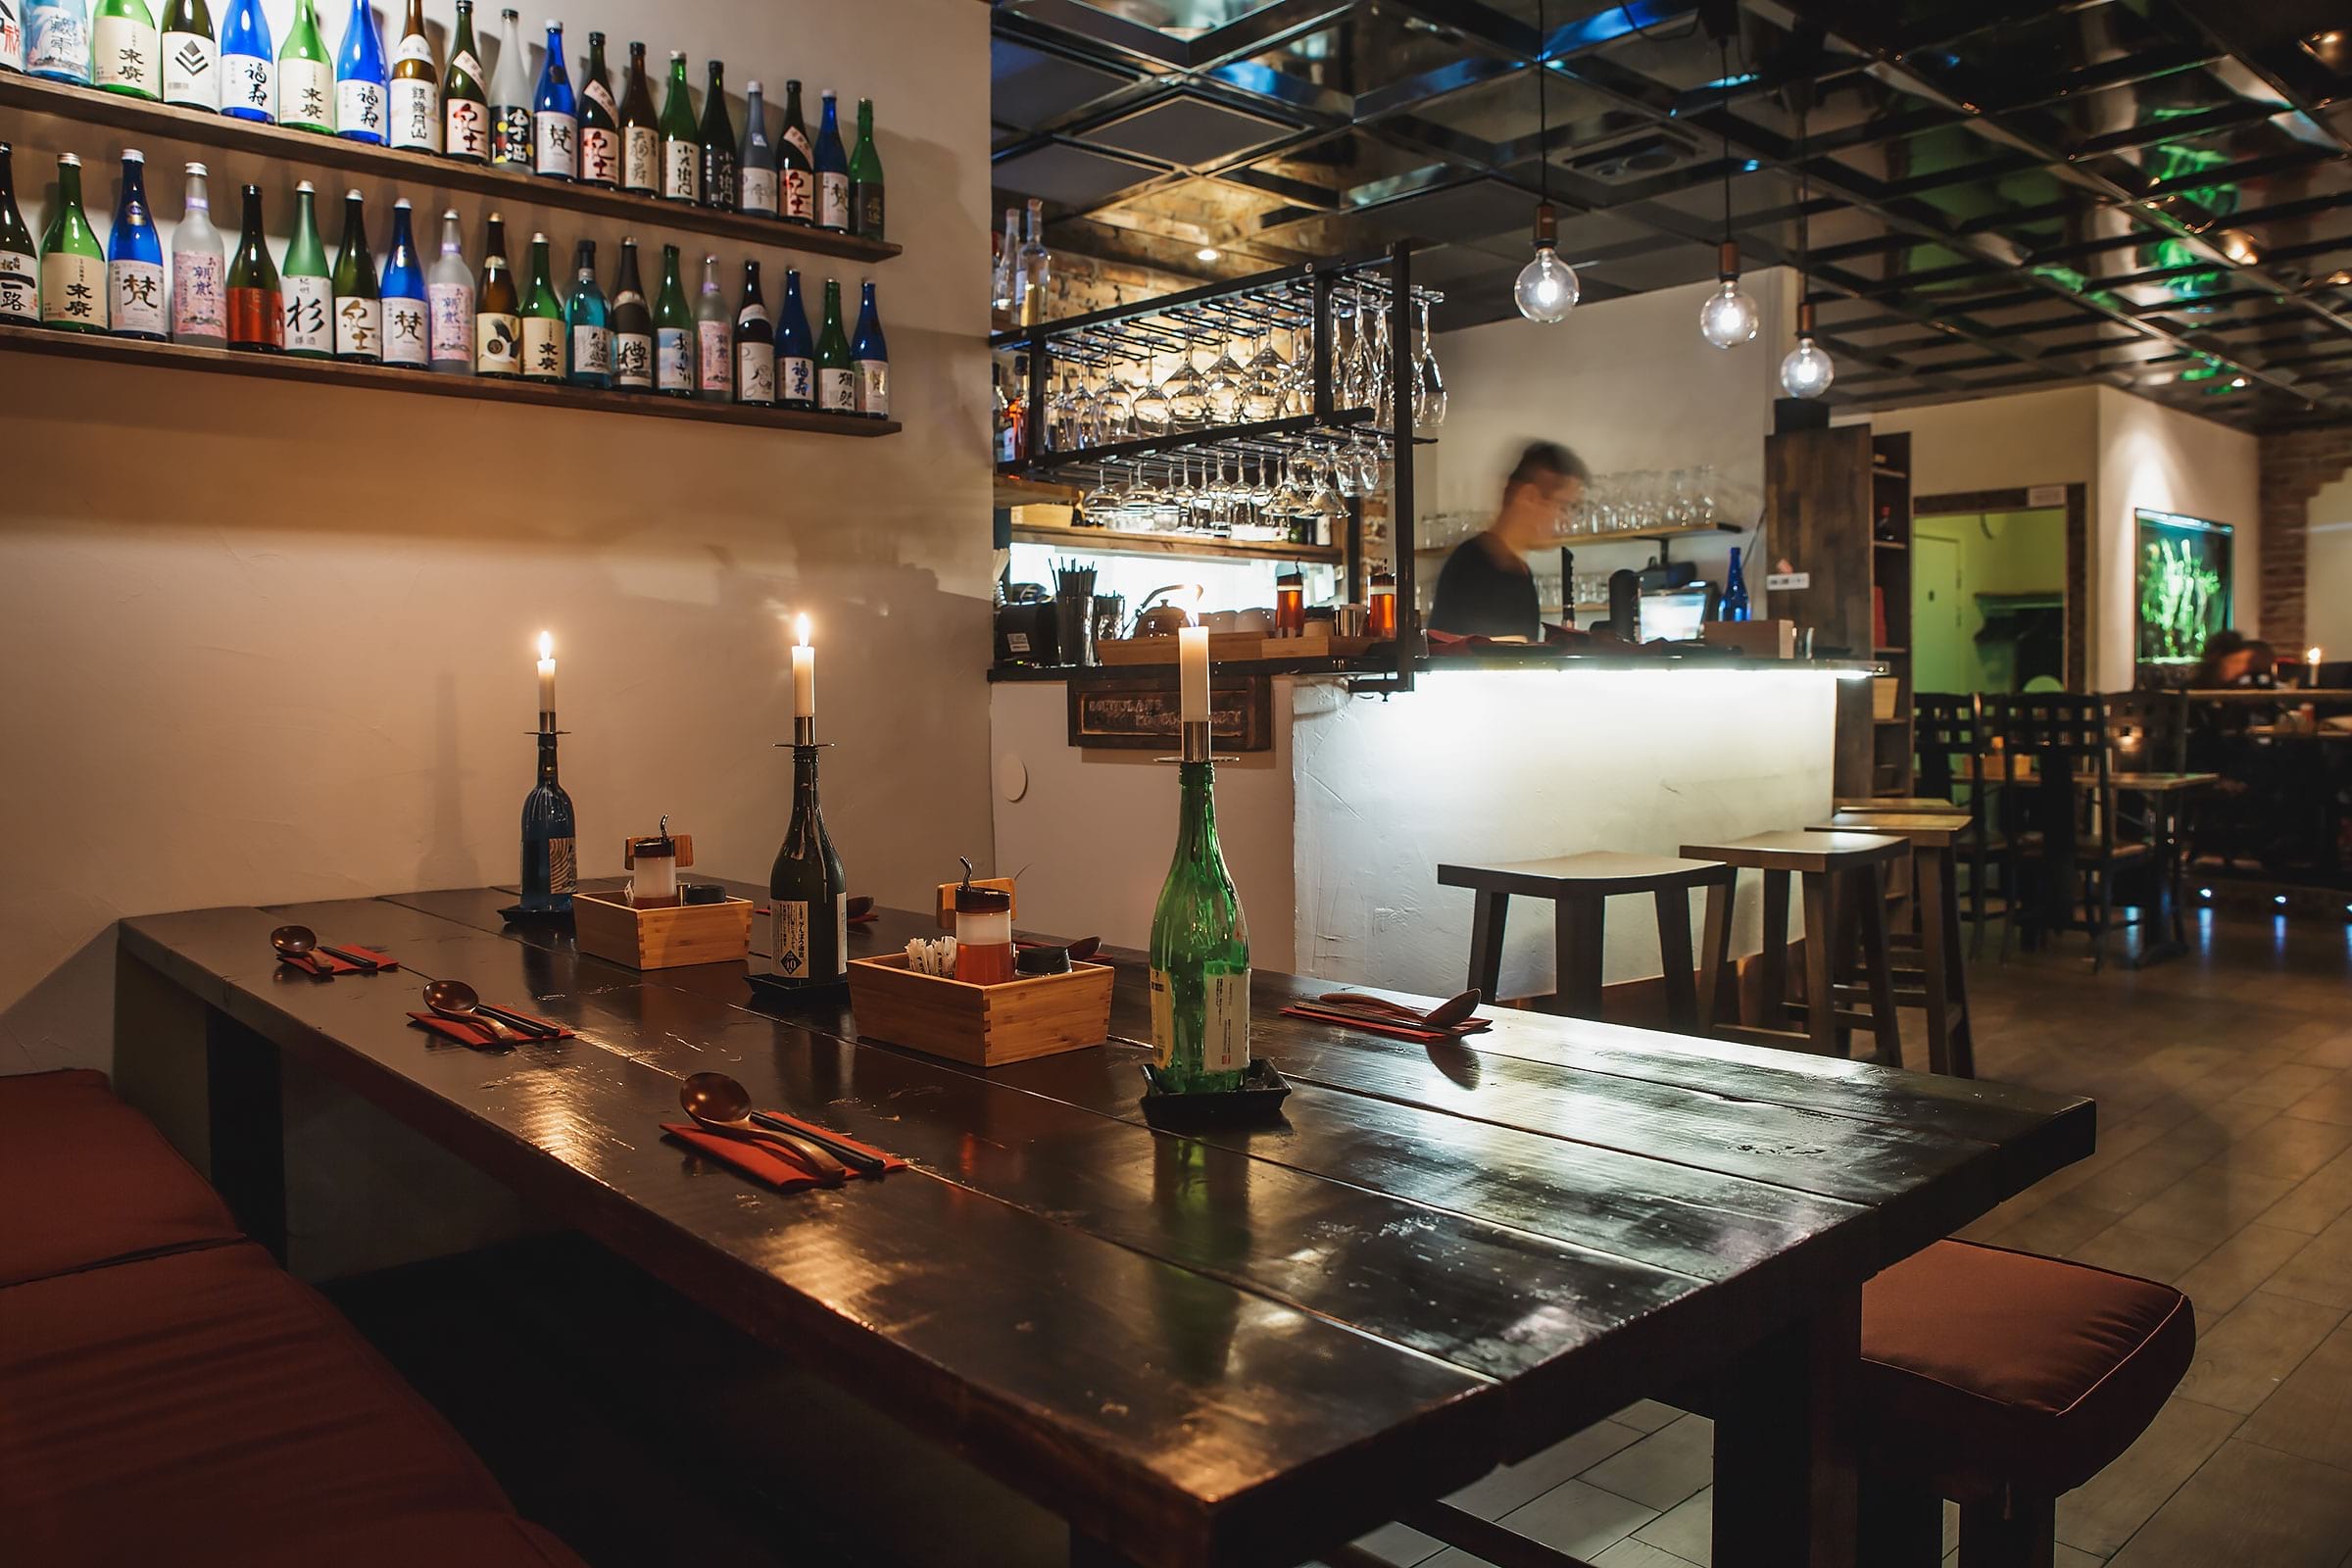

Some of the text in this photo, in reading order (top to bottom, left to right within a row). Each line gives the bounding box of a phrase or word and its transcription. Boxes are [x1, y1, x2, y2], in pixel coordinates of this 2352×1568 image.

[122, 273, 158, 309] 梵
[286, 295, 325, 333] 杉
[394, 310, 423, 341] 梵
